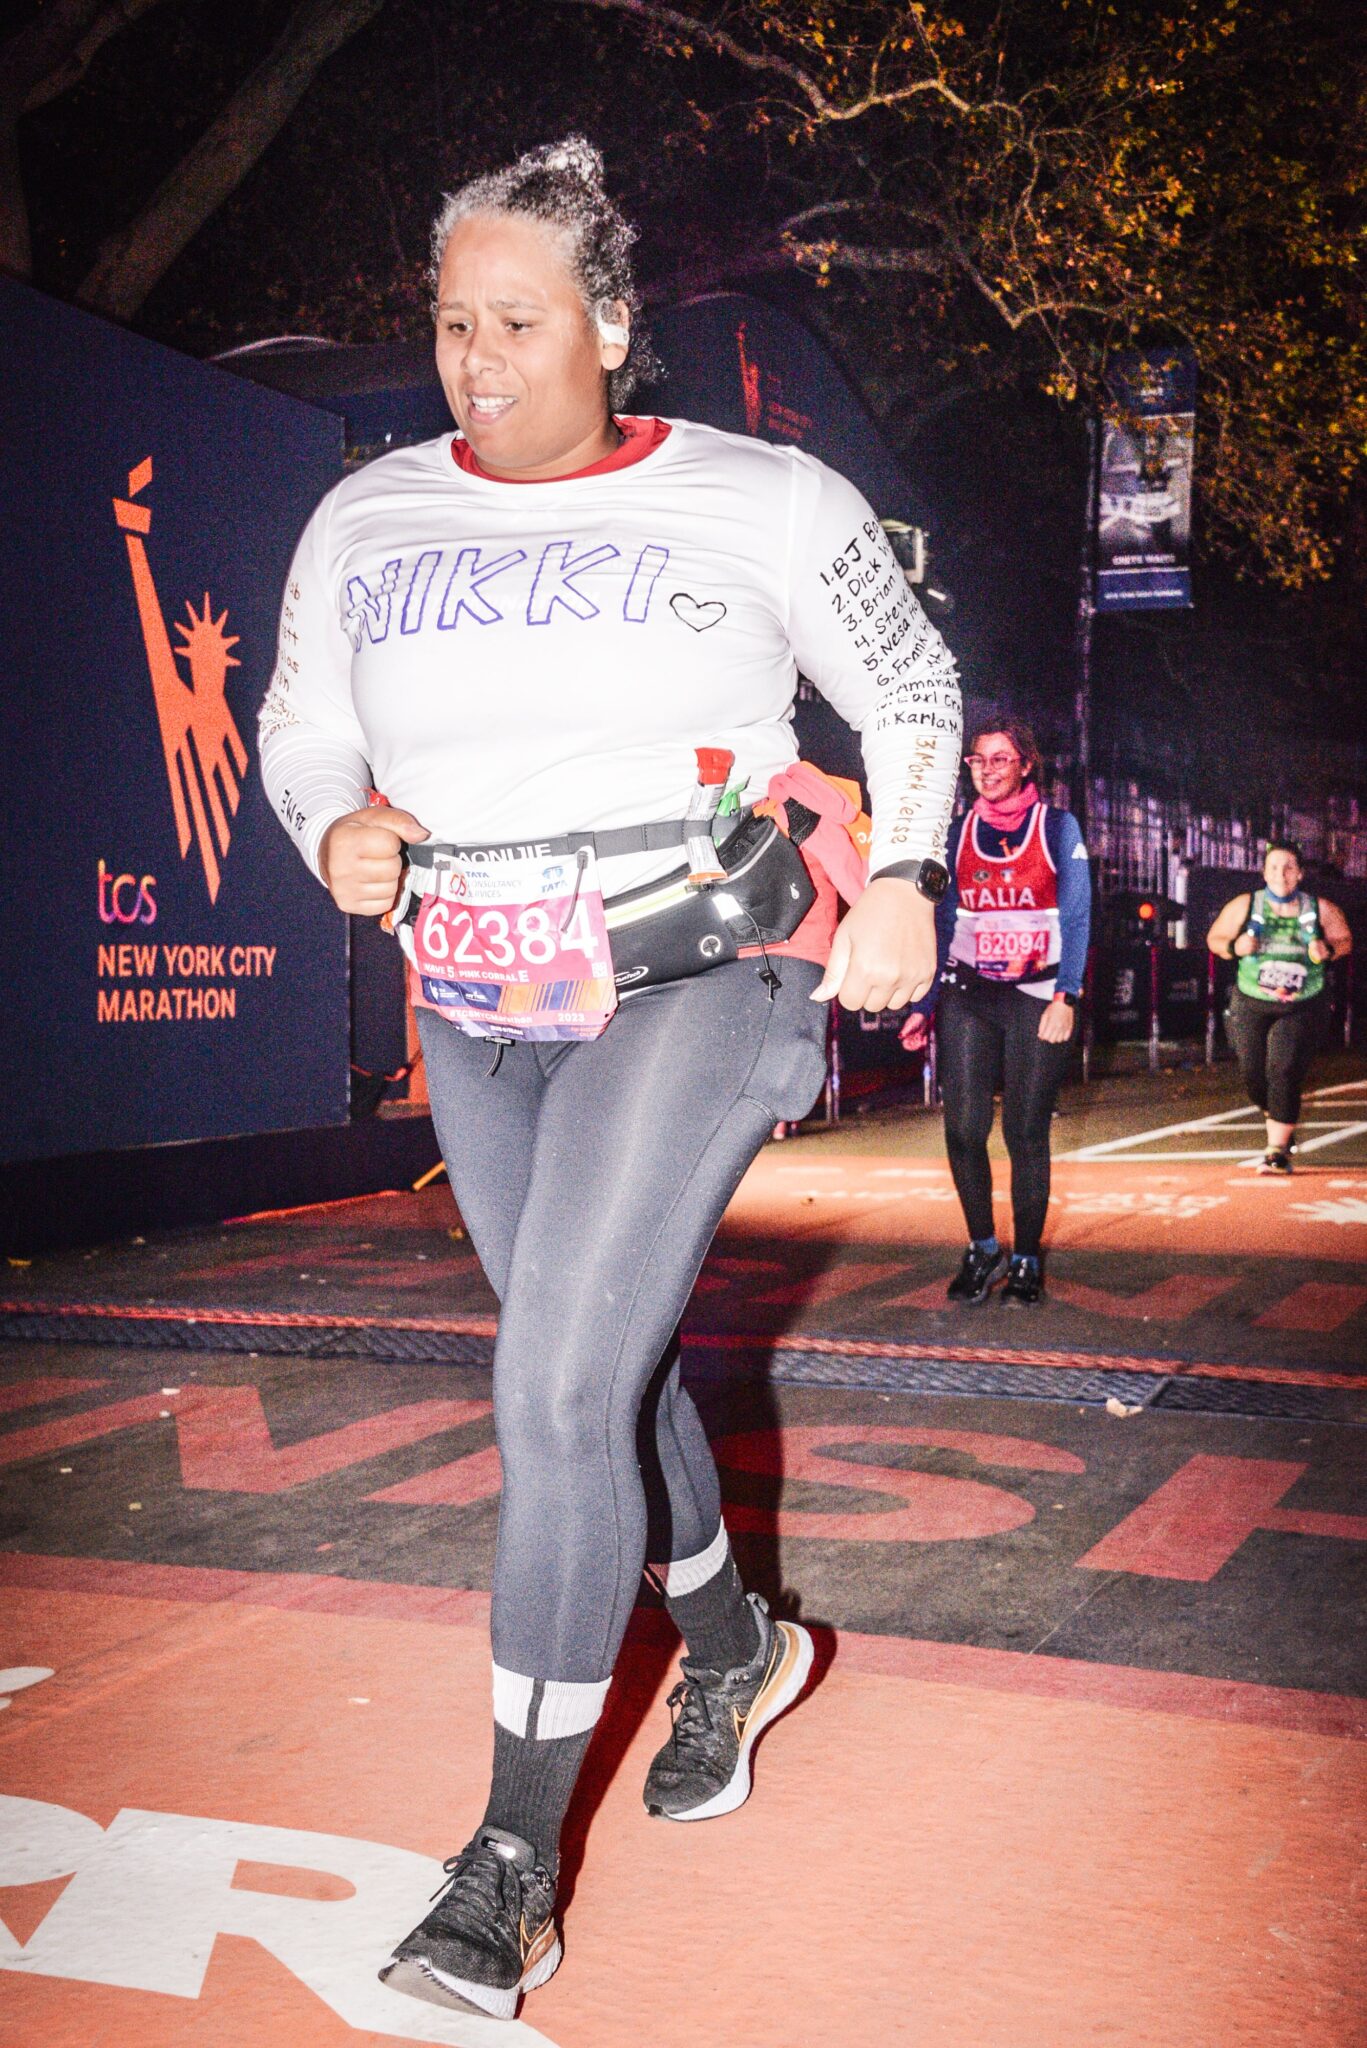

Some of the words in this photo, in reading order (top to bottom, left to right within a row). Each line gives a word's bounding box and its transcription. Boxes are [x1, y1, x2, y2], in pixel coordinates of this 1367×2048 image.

[848, 557, 882, 596] Dick
[347, 540, 670, 653] NIKKI
[861, 575, 897, 618] Brian
[881, 617, 911, 657] Nesa
[892, 632, 929, 676] Frank
[98, 859, 157, 925] tcs
[961, 887, 1037, 910] ITALIA
[421, 899, 599, 967] 62384
[978, 932, 1046, 956] 62094
[98, 944, 156, 978] NEW
[163, 944, 226, 977] YORK
[229, 944, 277, 977] CITY
[447, 966, 455, 979] 5
[459, 970, 481, 980] PINK
[481, 971, 518, 983] CORRAL
[518, 969, 530, 983] E
[98, 987, 236, 1023] MARATHON
[557, 1012, 585, 1023] 2023
